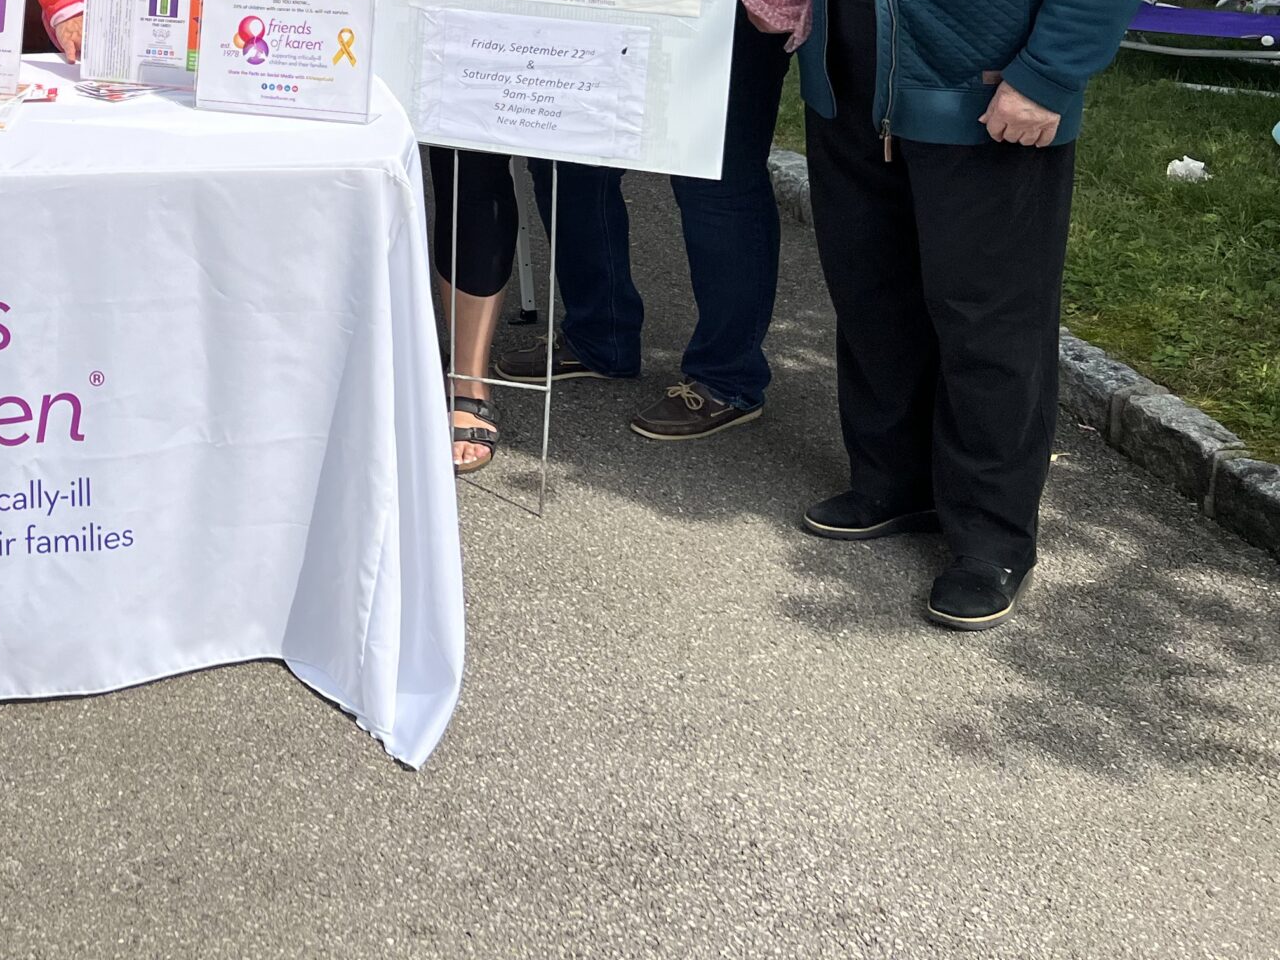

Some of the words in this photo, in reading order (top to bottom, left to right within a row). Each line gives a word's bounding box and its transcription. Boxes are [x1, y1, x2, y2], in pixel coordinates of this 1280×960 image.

[267, 19, 312, 36] friends
[271, 35, 284, 50] of
[471, 39, 506, 53] Friday,
[509, 42, 569, 58] September
[223, 49, 240, 57] 1978
[526, 60, 535, 70] &
[462, 68, 513, 84] Saturday,
[515, 74, 575, 90] September
[502, 88, 555, 104] 9am-5pm
[494, 102, 506, 111] 52
[507, 103, 536, 115] Alpine
[538, 107, 562, 118] Road
[497, 116, 517, 126] New
[519, 118, 558, 131] Rochelle
[24, 522, 134, 555] families
